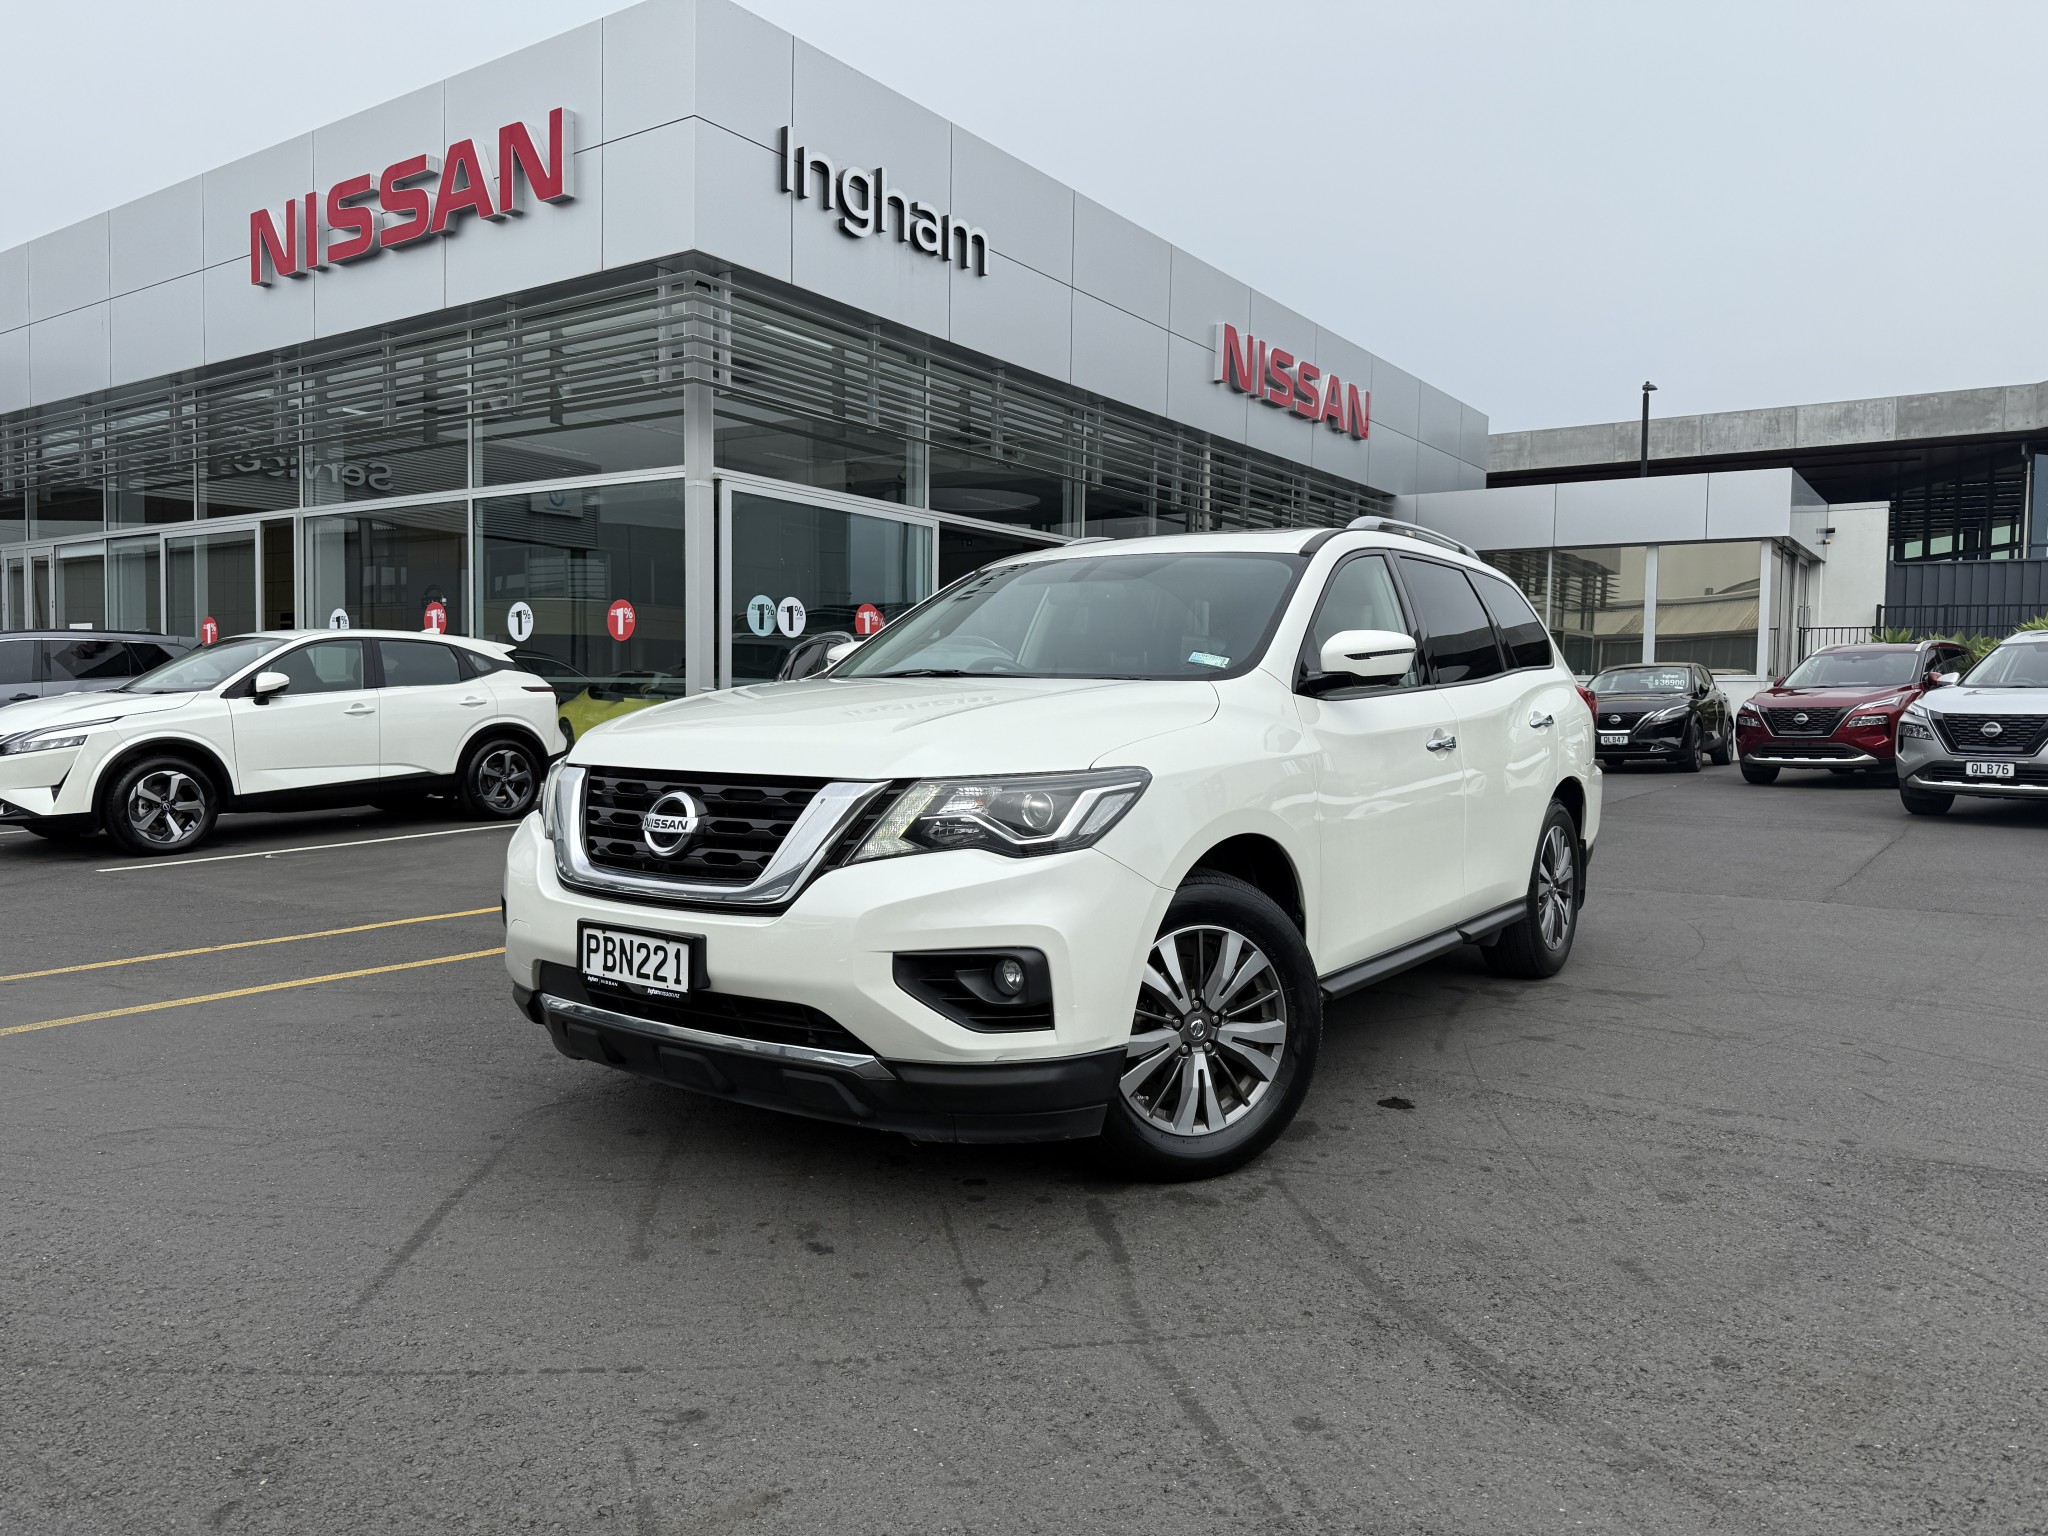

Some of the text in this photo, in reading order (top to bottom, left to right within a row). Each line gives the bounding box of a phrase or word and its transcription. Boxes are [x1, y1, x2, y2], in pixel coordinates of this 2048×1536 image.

[250, 106, 571, 286] NISSAN
[781, 126, 989, 276] Ingham
[1217, 322, 1370, 440] NISSAN
[1971, 763, 2009, 775] QLB76
[645, 818, 688, 830] NISSAN
[586, 933, 682, 985] PBN221
